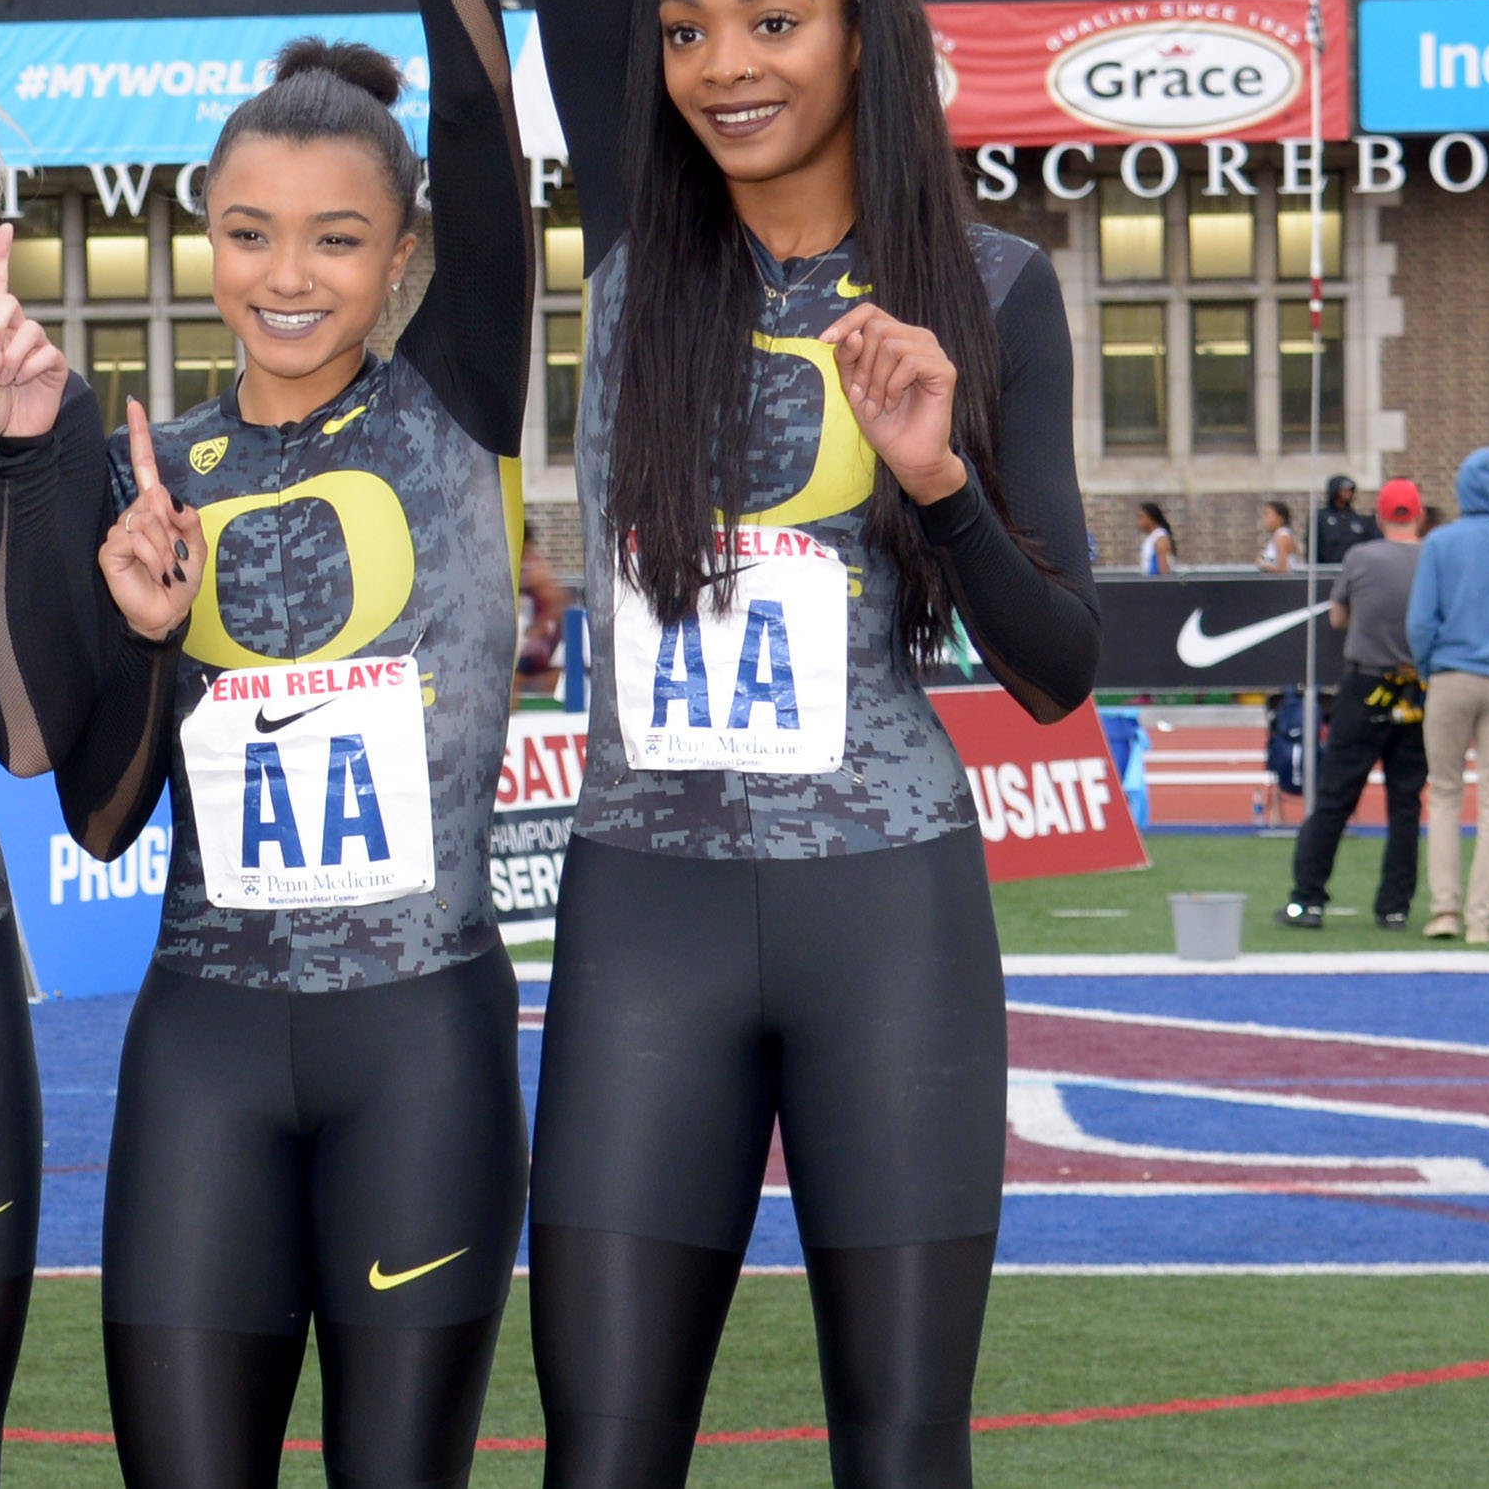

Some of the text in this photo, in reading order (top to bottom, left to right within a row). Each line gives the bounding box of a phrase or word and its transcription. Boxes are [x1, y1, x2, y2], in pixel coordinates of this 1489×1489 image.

[1084, 61, 1264, 100] Grace
[212, 674, 271, 702] ENN
[286, 661, 405, 697] RELAYS
[651, 599, 801, 730] AA
[241, 733, 391, 868] AA
[965, 757, 1111, 842] USATF
[267, 870, 395, 894] Penn Medicine
